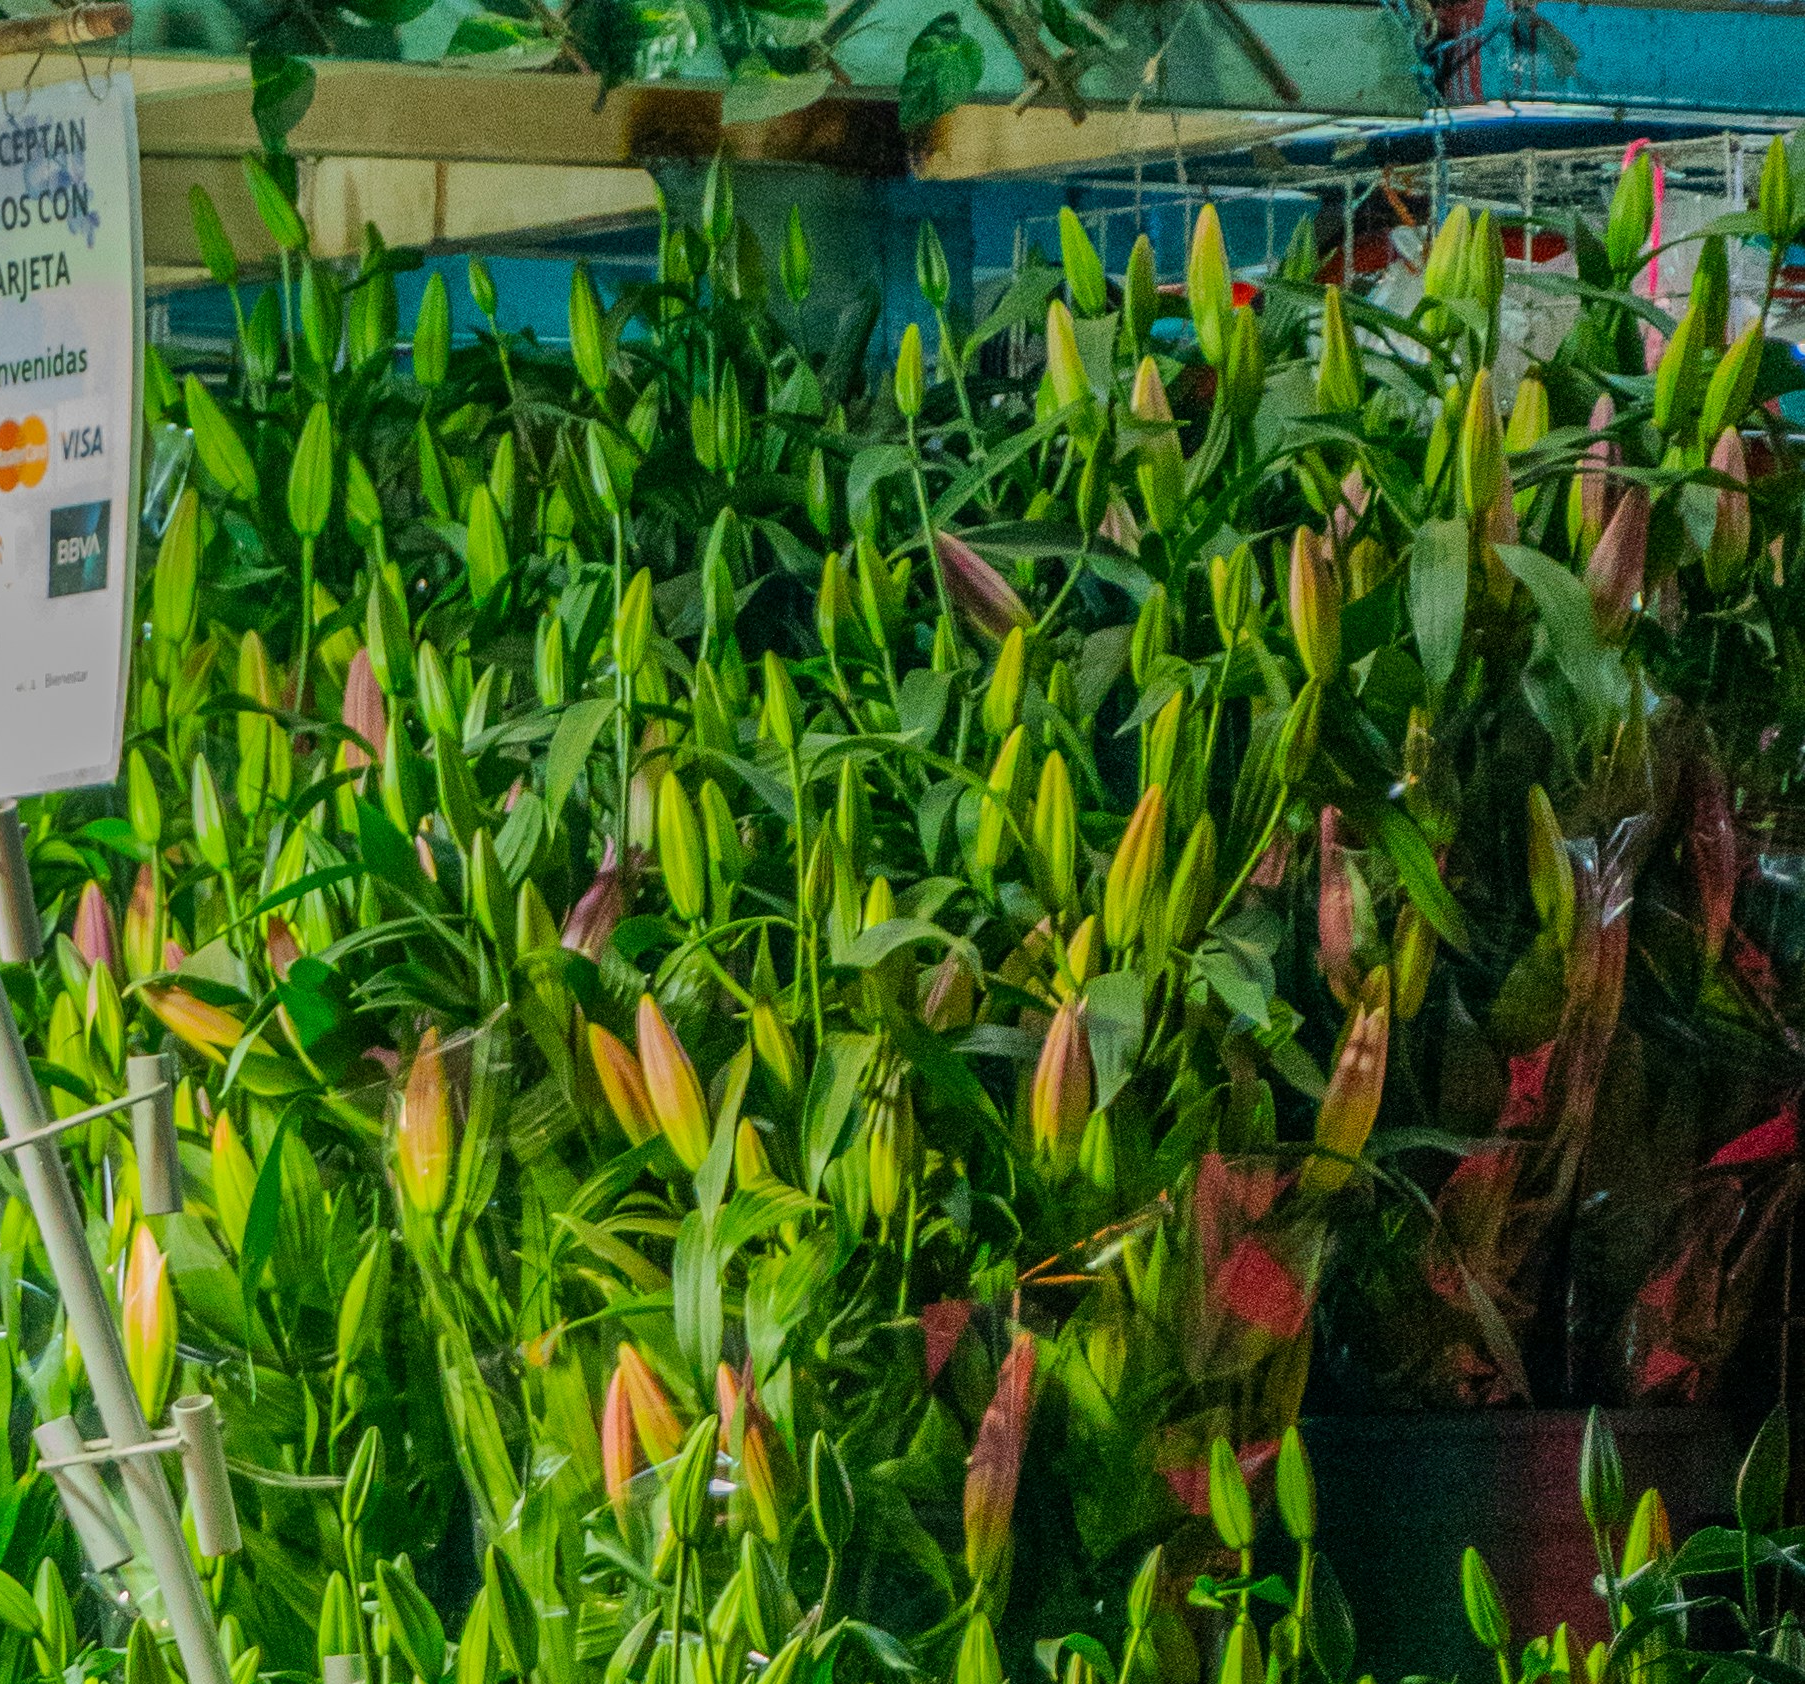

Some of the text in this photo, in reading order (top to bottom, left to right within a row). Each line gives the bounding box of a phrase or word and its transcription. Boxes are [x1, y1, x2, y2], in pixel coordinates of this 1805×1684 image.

[38, 184, 89, 224] CON
[60, 424, 103, 460] VISA
[57, 532, 100, 565] BBVA
